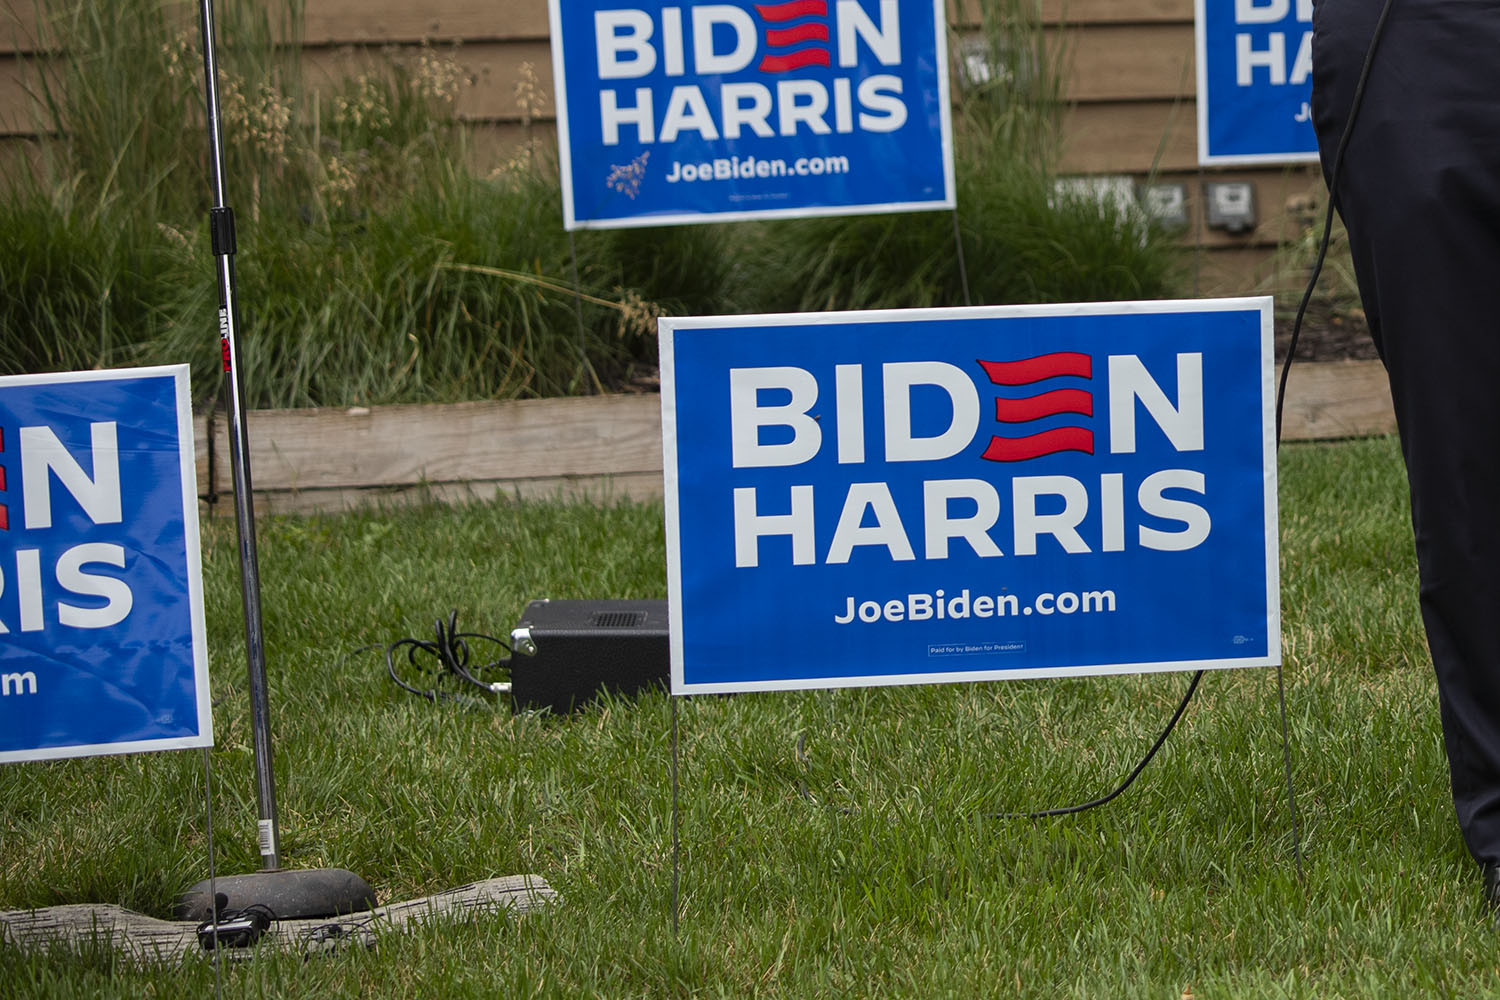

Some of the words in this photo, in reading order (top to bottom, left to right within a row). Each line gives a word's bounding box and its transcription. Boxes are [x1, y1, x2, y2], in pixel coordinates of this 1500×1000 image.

[600, 74, 907, 145] HARRIS
[667, 155, 849, 183] JoeBiden.com
[730, 352, 1204, 469] BIDEN
[0, 420, 122, 530] N
[734, 469, 1212, 568] HARRIS
[0, 543, 132, 634] IS
[834, 590, 1116, 624] JoeBiden.com
[930, 646, 945, 654] Paid
[955, 645, 964, 653] by
[965, 644, 983, 652] Biden
[983, 644, 993, 652] for
[994, 643, 1024, 651] President
